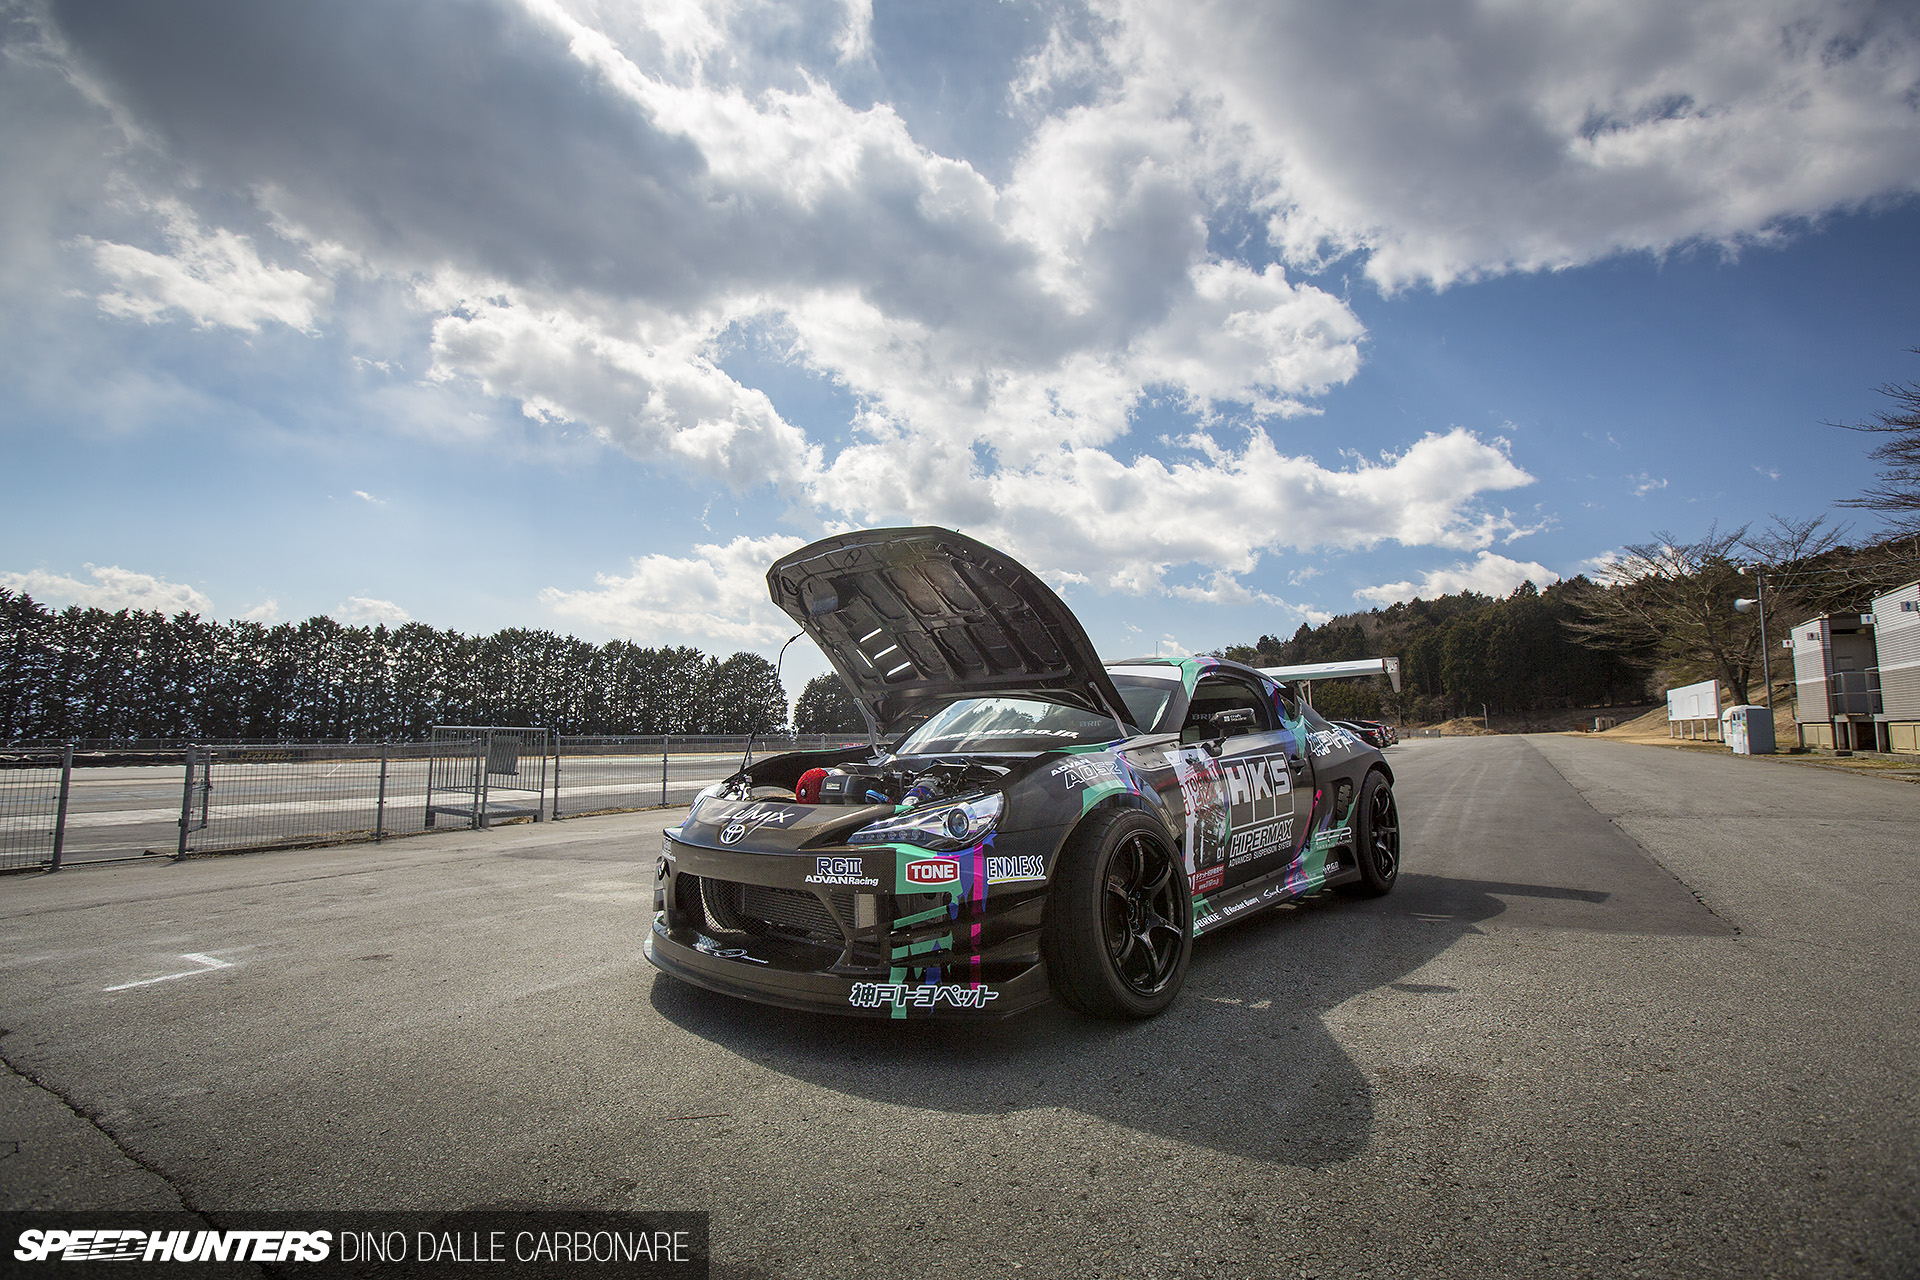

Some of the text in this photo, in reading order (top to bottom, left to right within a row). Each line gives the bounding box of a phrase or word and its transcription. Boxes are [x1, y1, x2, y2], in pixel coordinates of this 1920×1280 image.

[1050, 758, 1091, 777] ADVAN
[1224, 759, 1291, 806] HKS
[718, 806, 795, 824] LUMIX
[1229, 818, 1294, 858] HIPERMAX
[1228, 840, 1292, 868] ADVANCED SUSPENSION SYSTEM
[911, 865, 955, 879] TONE
[986, 855, 1045, 879] ENDLESS
[805, 874, 879, 887] ADVAN Racing
[849, 982, 999, 1008] 神戸トヨペット
